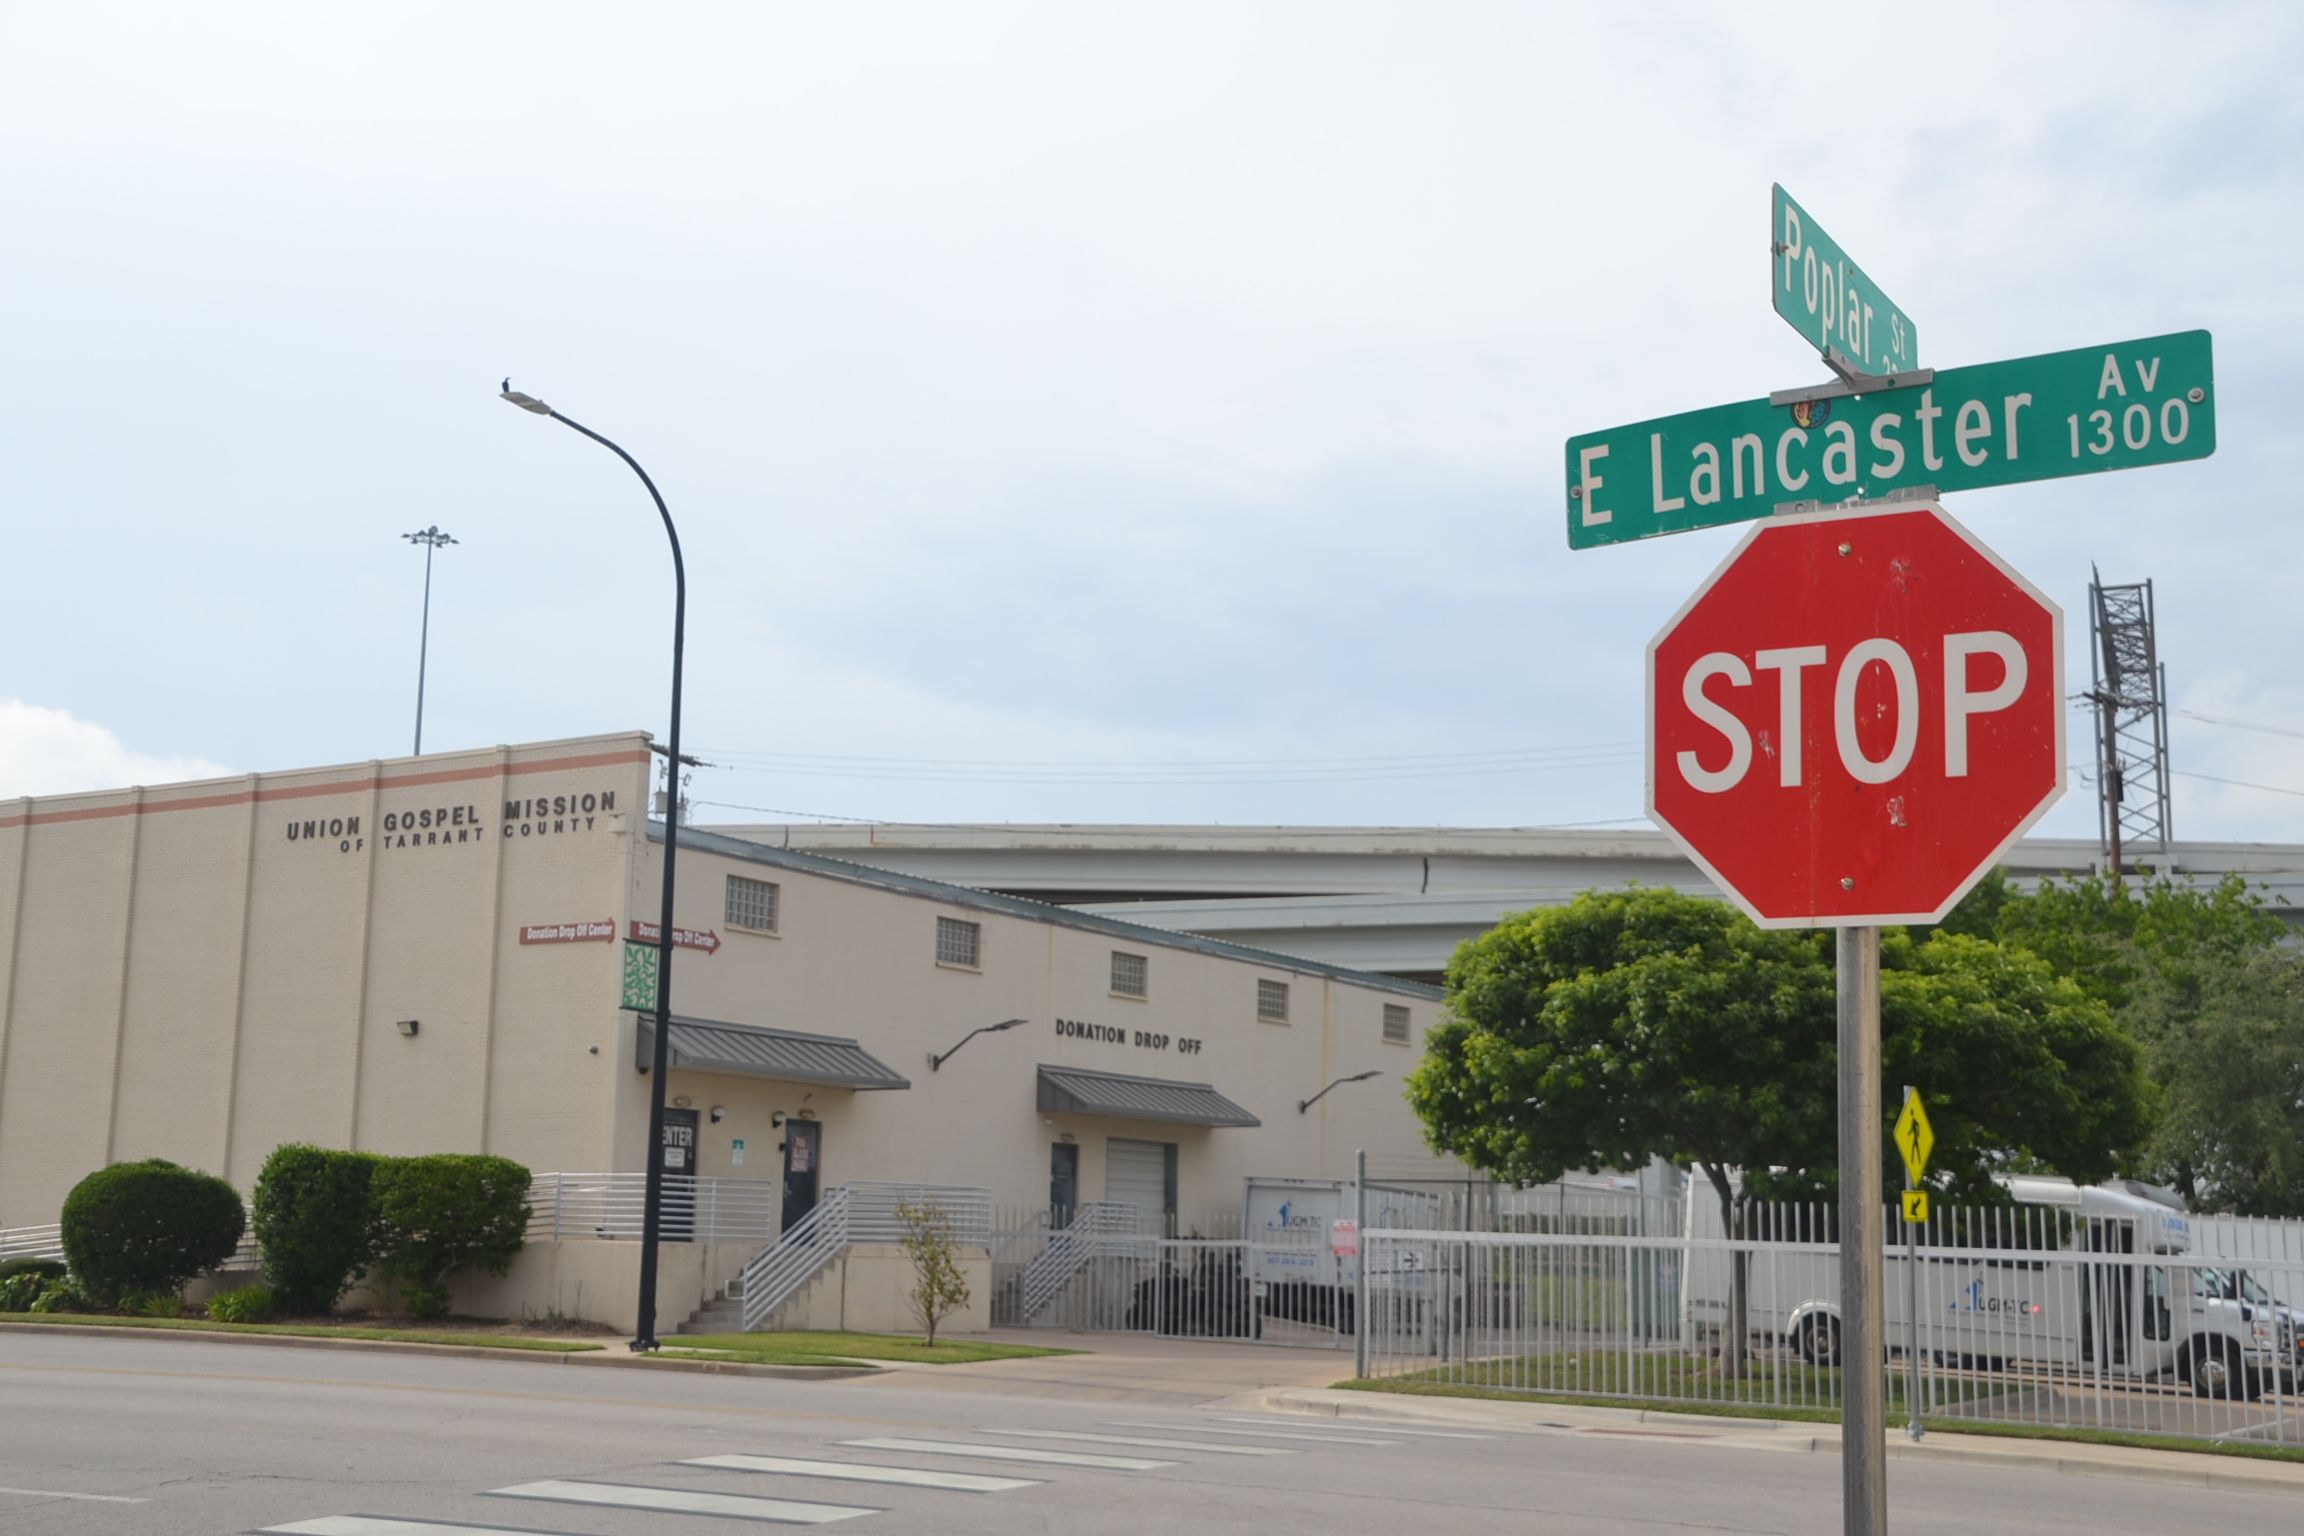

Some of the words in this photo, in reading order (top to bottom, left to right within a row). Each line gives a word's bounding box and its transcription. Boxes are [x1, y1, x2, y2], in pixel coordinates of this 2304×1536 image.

[1785, 203, 1874, 365] Poplar
[1891, 312, 1906, 361] St
[2097, 354, 2161, 400] Av
[2067, 397, 2191, 459] 1300
[1580, 443, 1613, 528] E
[1650, 388, 2033, 515] Lancaster
[1676, 630, 2029, 794] STOP
[287, 816, 360, 841] UNION
[384, 805, 479, 832] GOSPEL
[504, 791, 615, 820] MISSION
[340, 838, 363, 853] OF
[384, 827, 483, 849] TARRANT
[504, 816, 595, 838] COUNTY
[527, 927, 558, 940] Donation
[559, 926, 575, 940] Drop
[577, 924, 588, 937] Off
[588, 923, 612, 936] Center
[1056, 1018, 1126, 1044] DONATION
[1135, 1031, 1169, 1050] DROP
[1178, 1038, 1202, 1055] OFF
